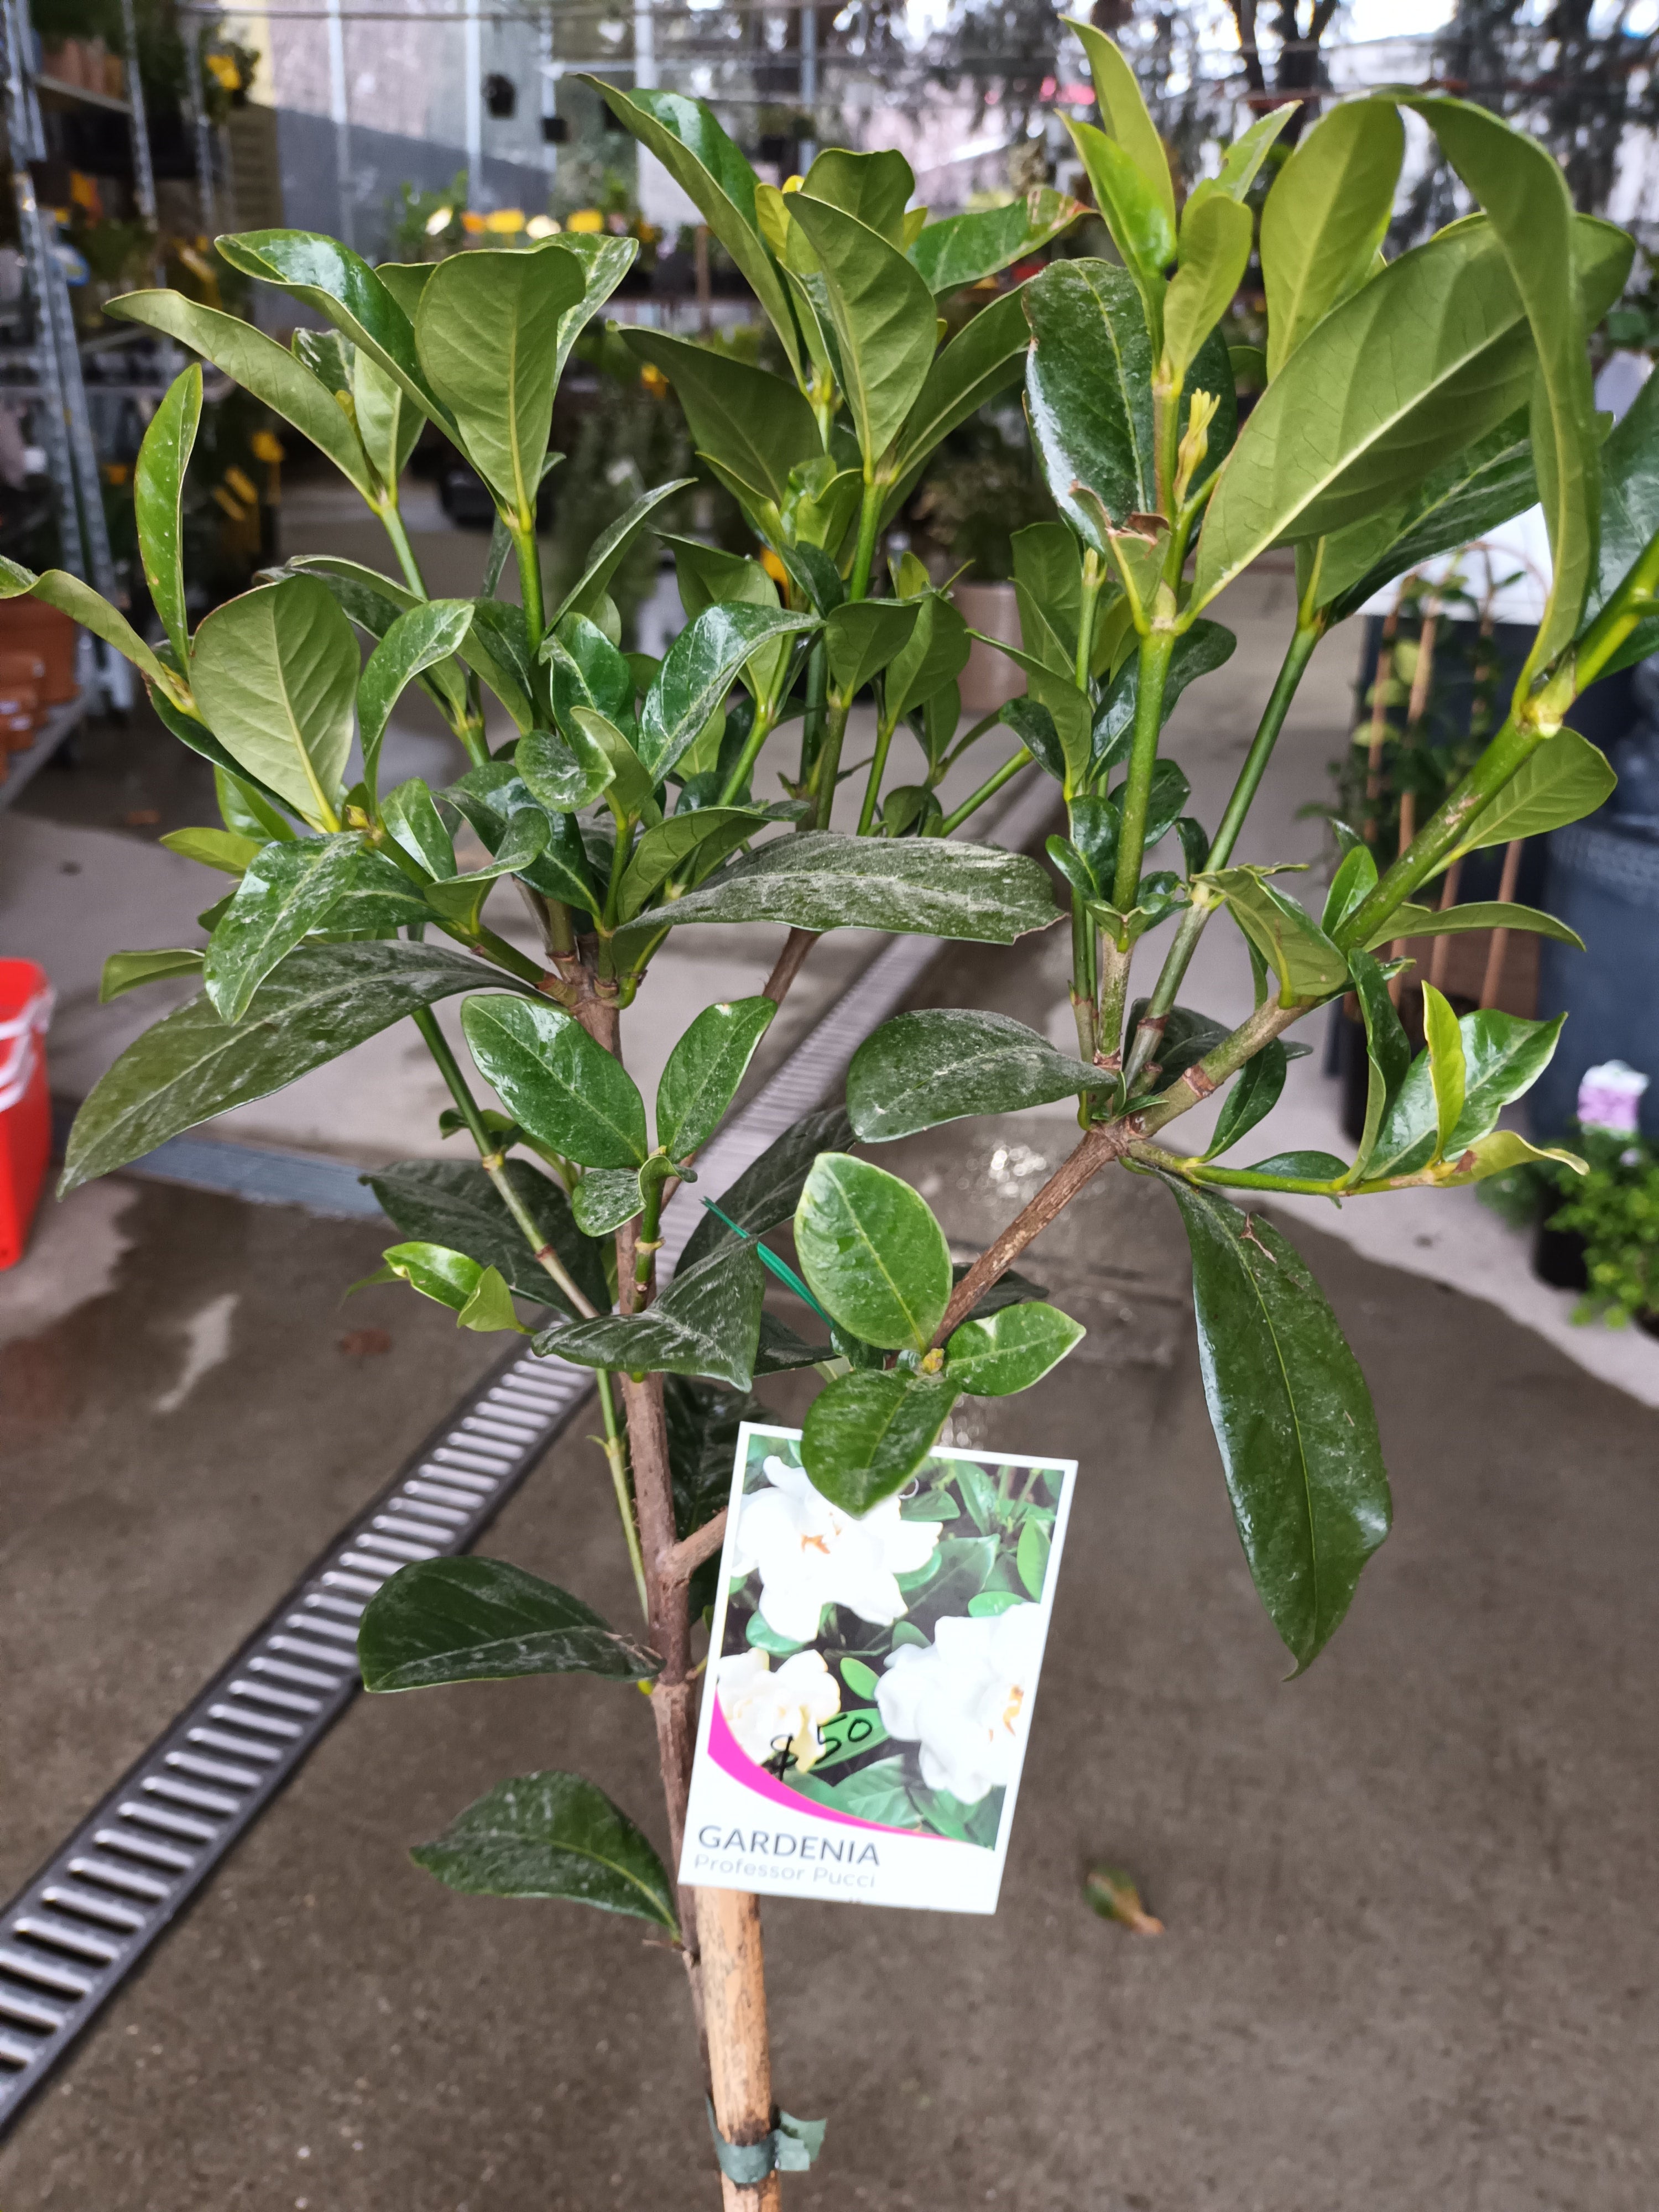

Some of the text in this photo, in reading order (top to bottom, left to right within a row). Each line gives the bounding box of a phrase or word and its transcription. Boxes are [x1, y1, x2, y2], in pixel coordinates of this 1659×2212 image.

[698, 1825, 880, 1867] GARDENIA
[695, 1854, 877, 1888] Professor Pucci
